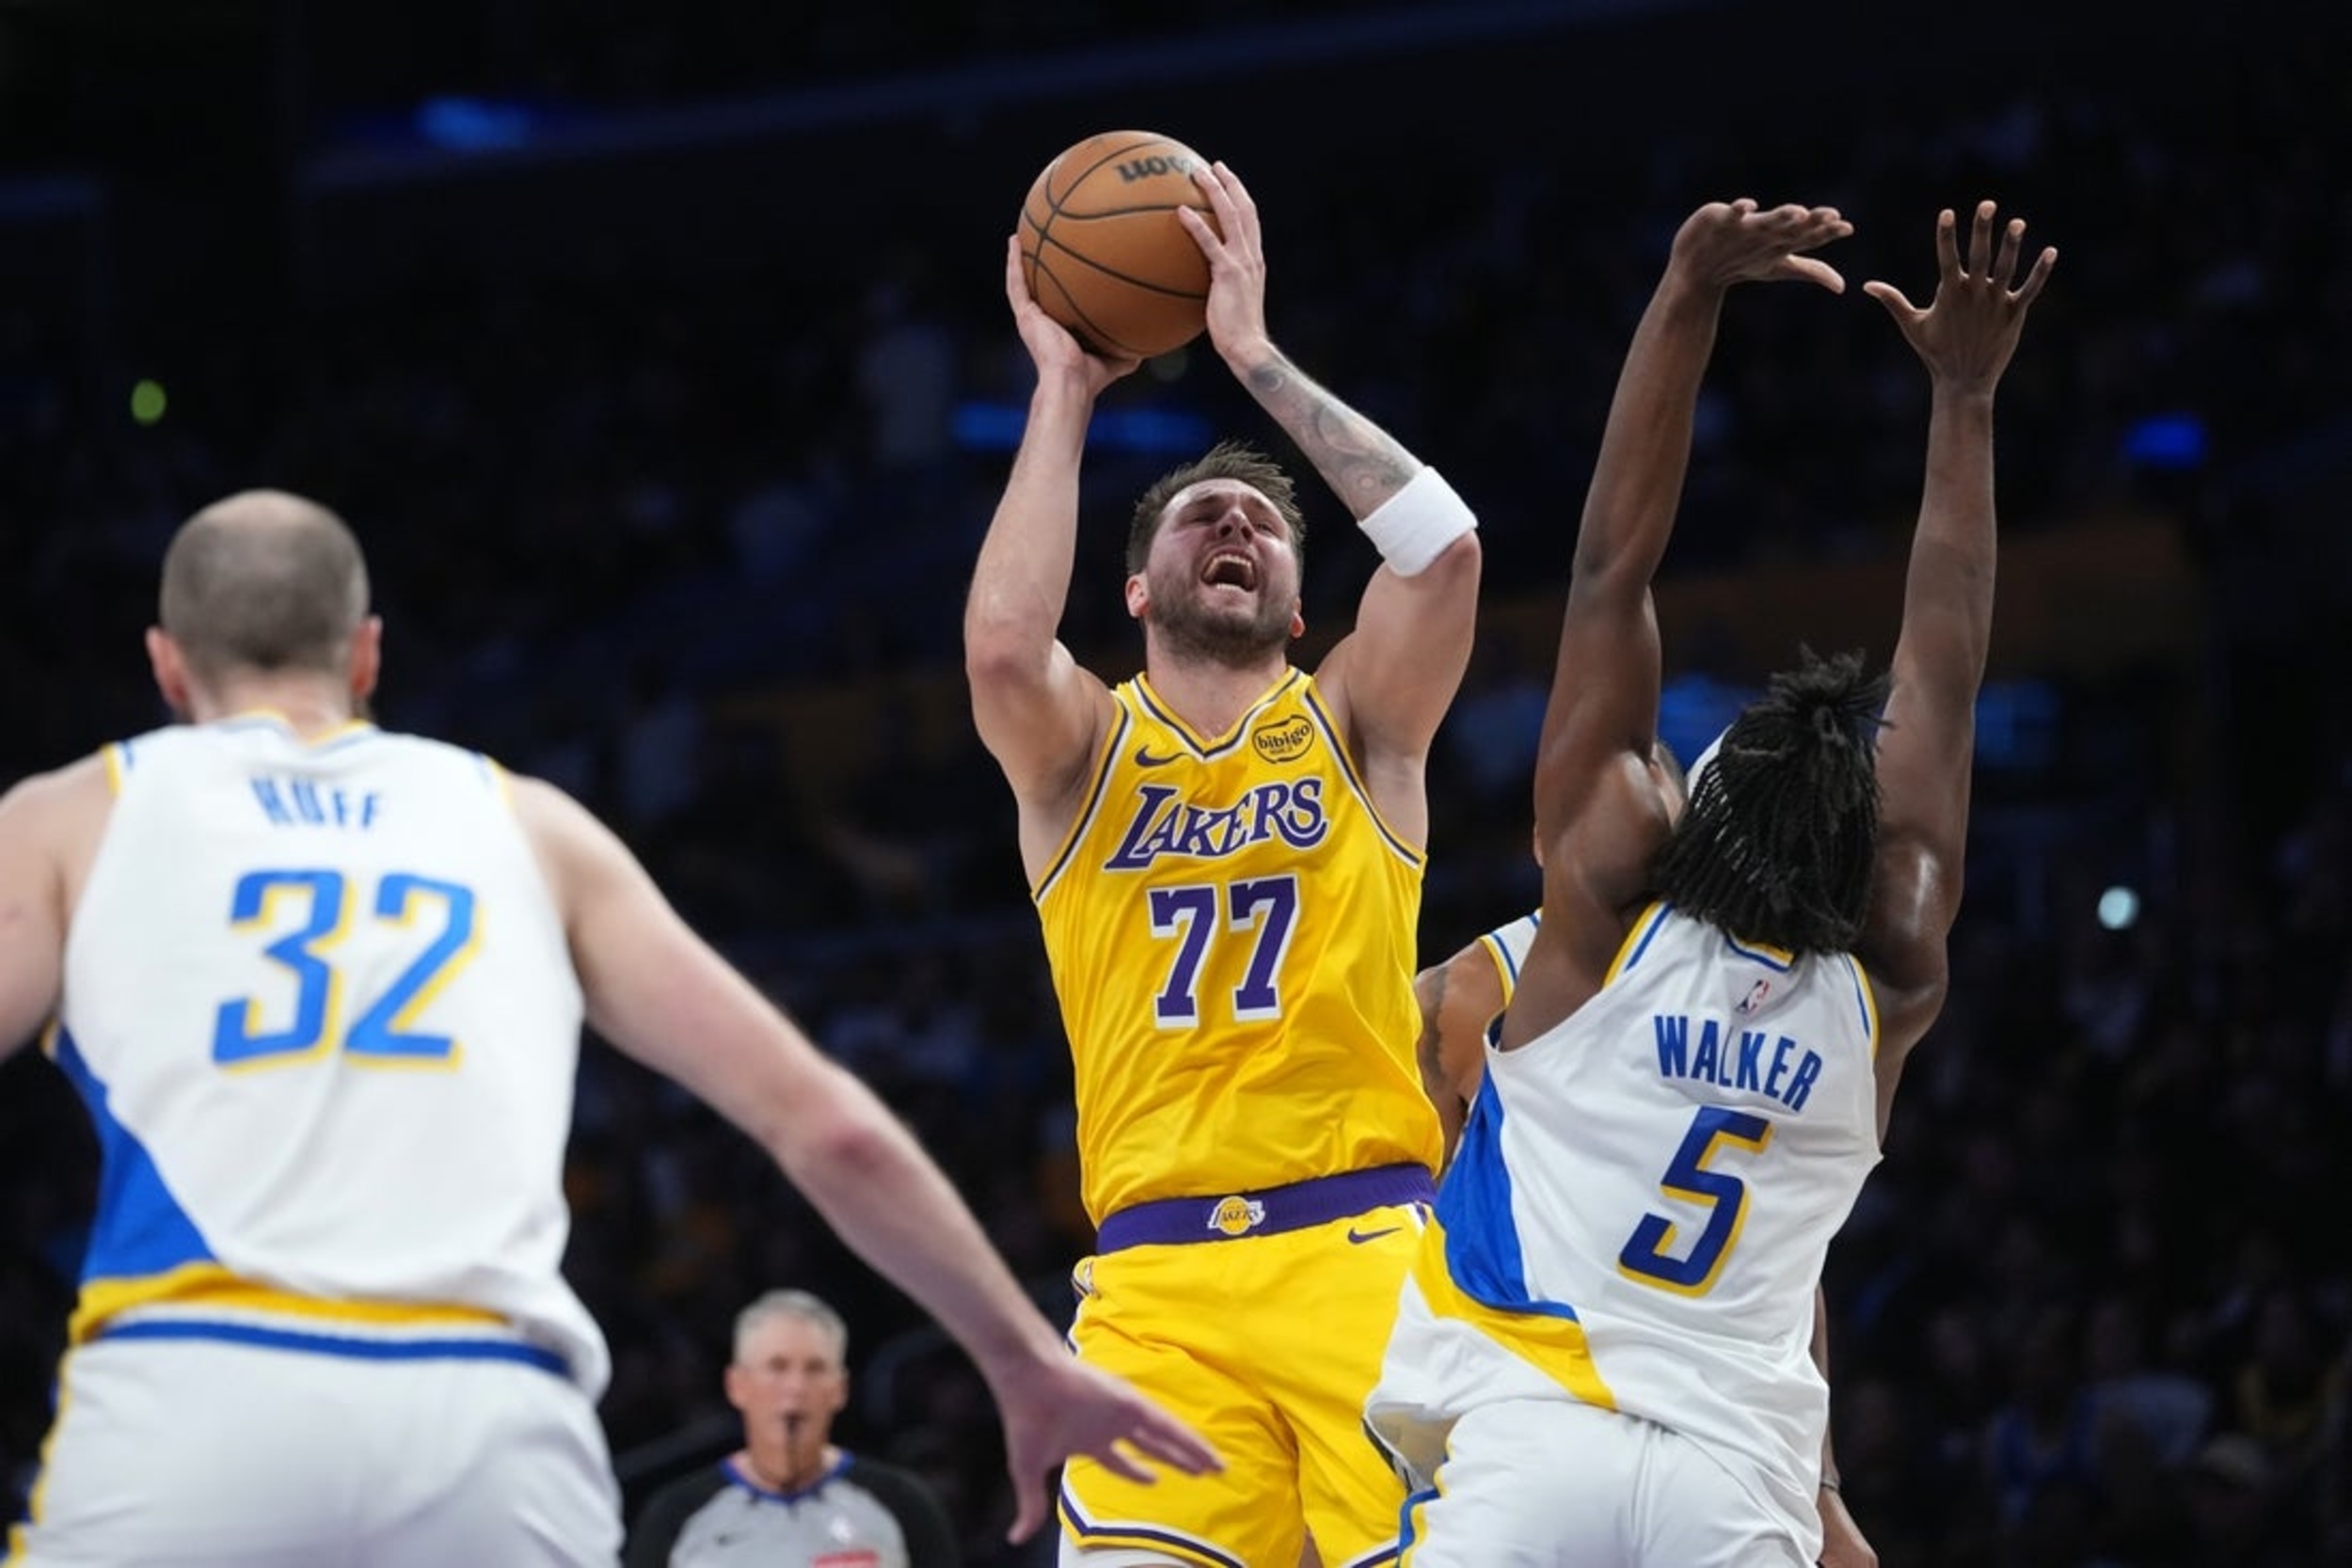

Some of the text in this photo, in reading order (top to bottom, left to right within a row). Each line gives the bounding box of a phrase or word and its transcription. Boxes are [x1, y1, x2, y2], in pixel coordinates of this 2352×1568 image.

[1258, 724, 1310, 749] bibigo
[1103, 777, 1328, 872] LAKERS
[213, 869, 485, 1072] 32
[1147, 873, 1298, 1029] 77
[1654, 1015, 1822, 1112] WALKER
[1617, 1104, 1774, 1299] 5
